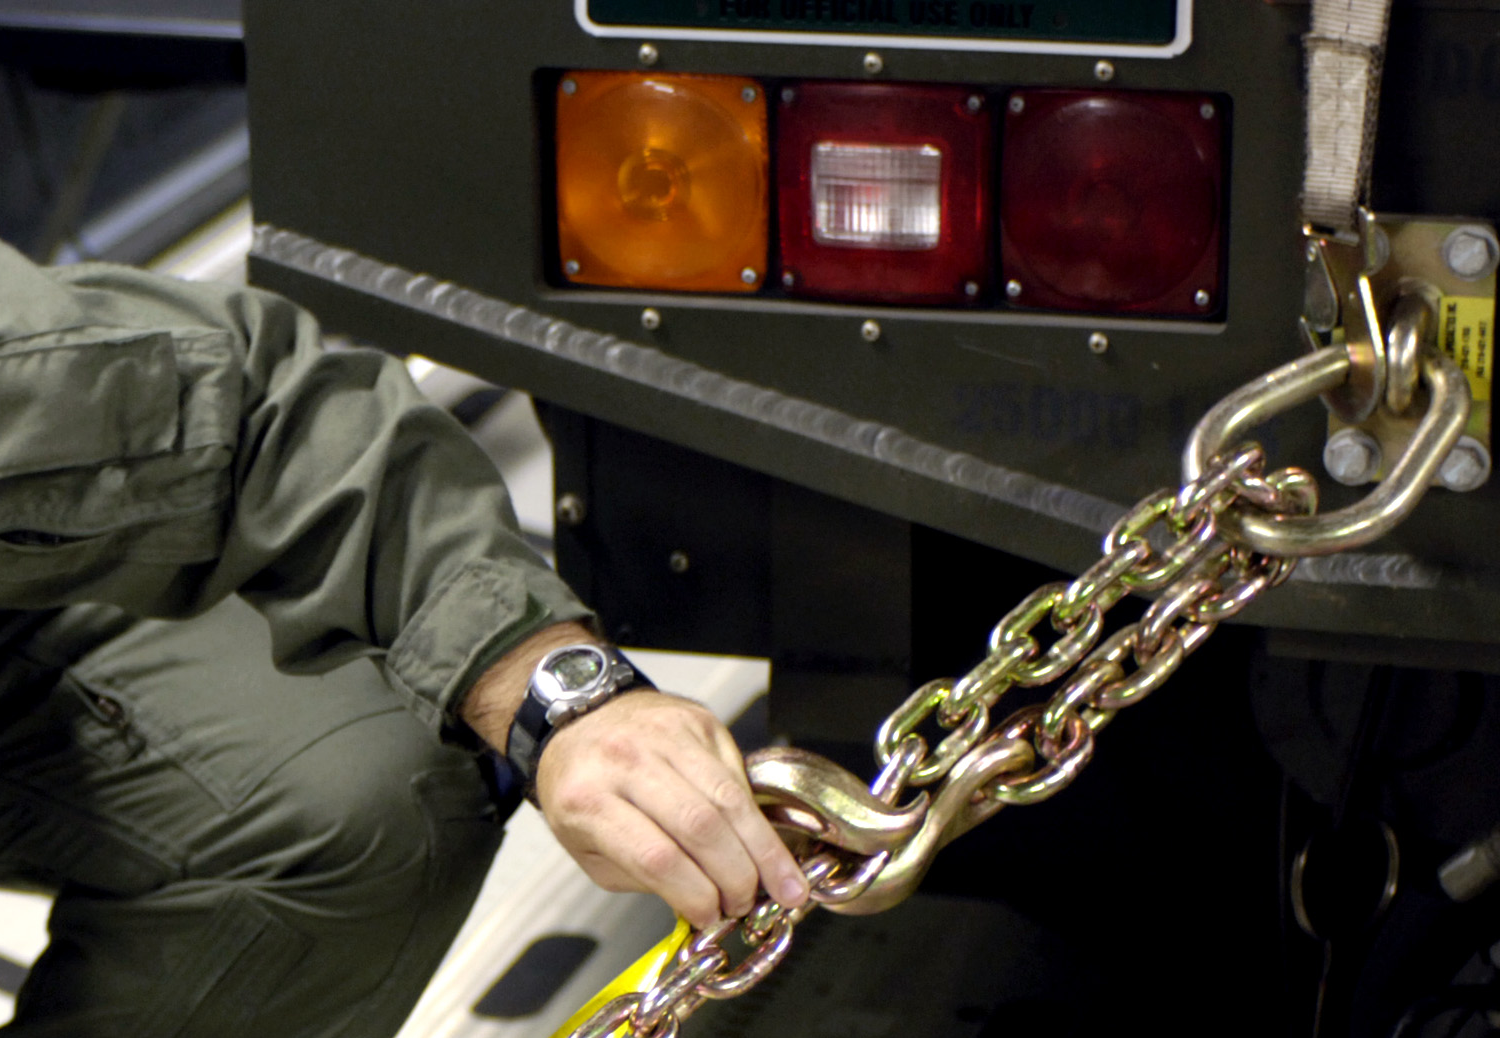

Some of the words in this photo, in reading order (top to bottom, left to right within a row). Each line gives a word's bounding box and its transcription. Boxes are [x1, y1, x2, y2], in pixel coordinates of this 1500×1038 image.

[719, 0, 770, 19] FOR
[781, 0, 898, 24] OFFICIAL
[908, 0, 958, 27] USE
[969, 2, 1035, 29] ONLY
